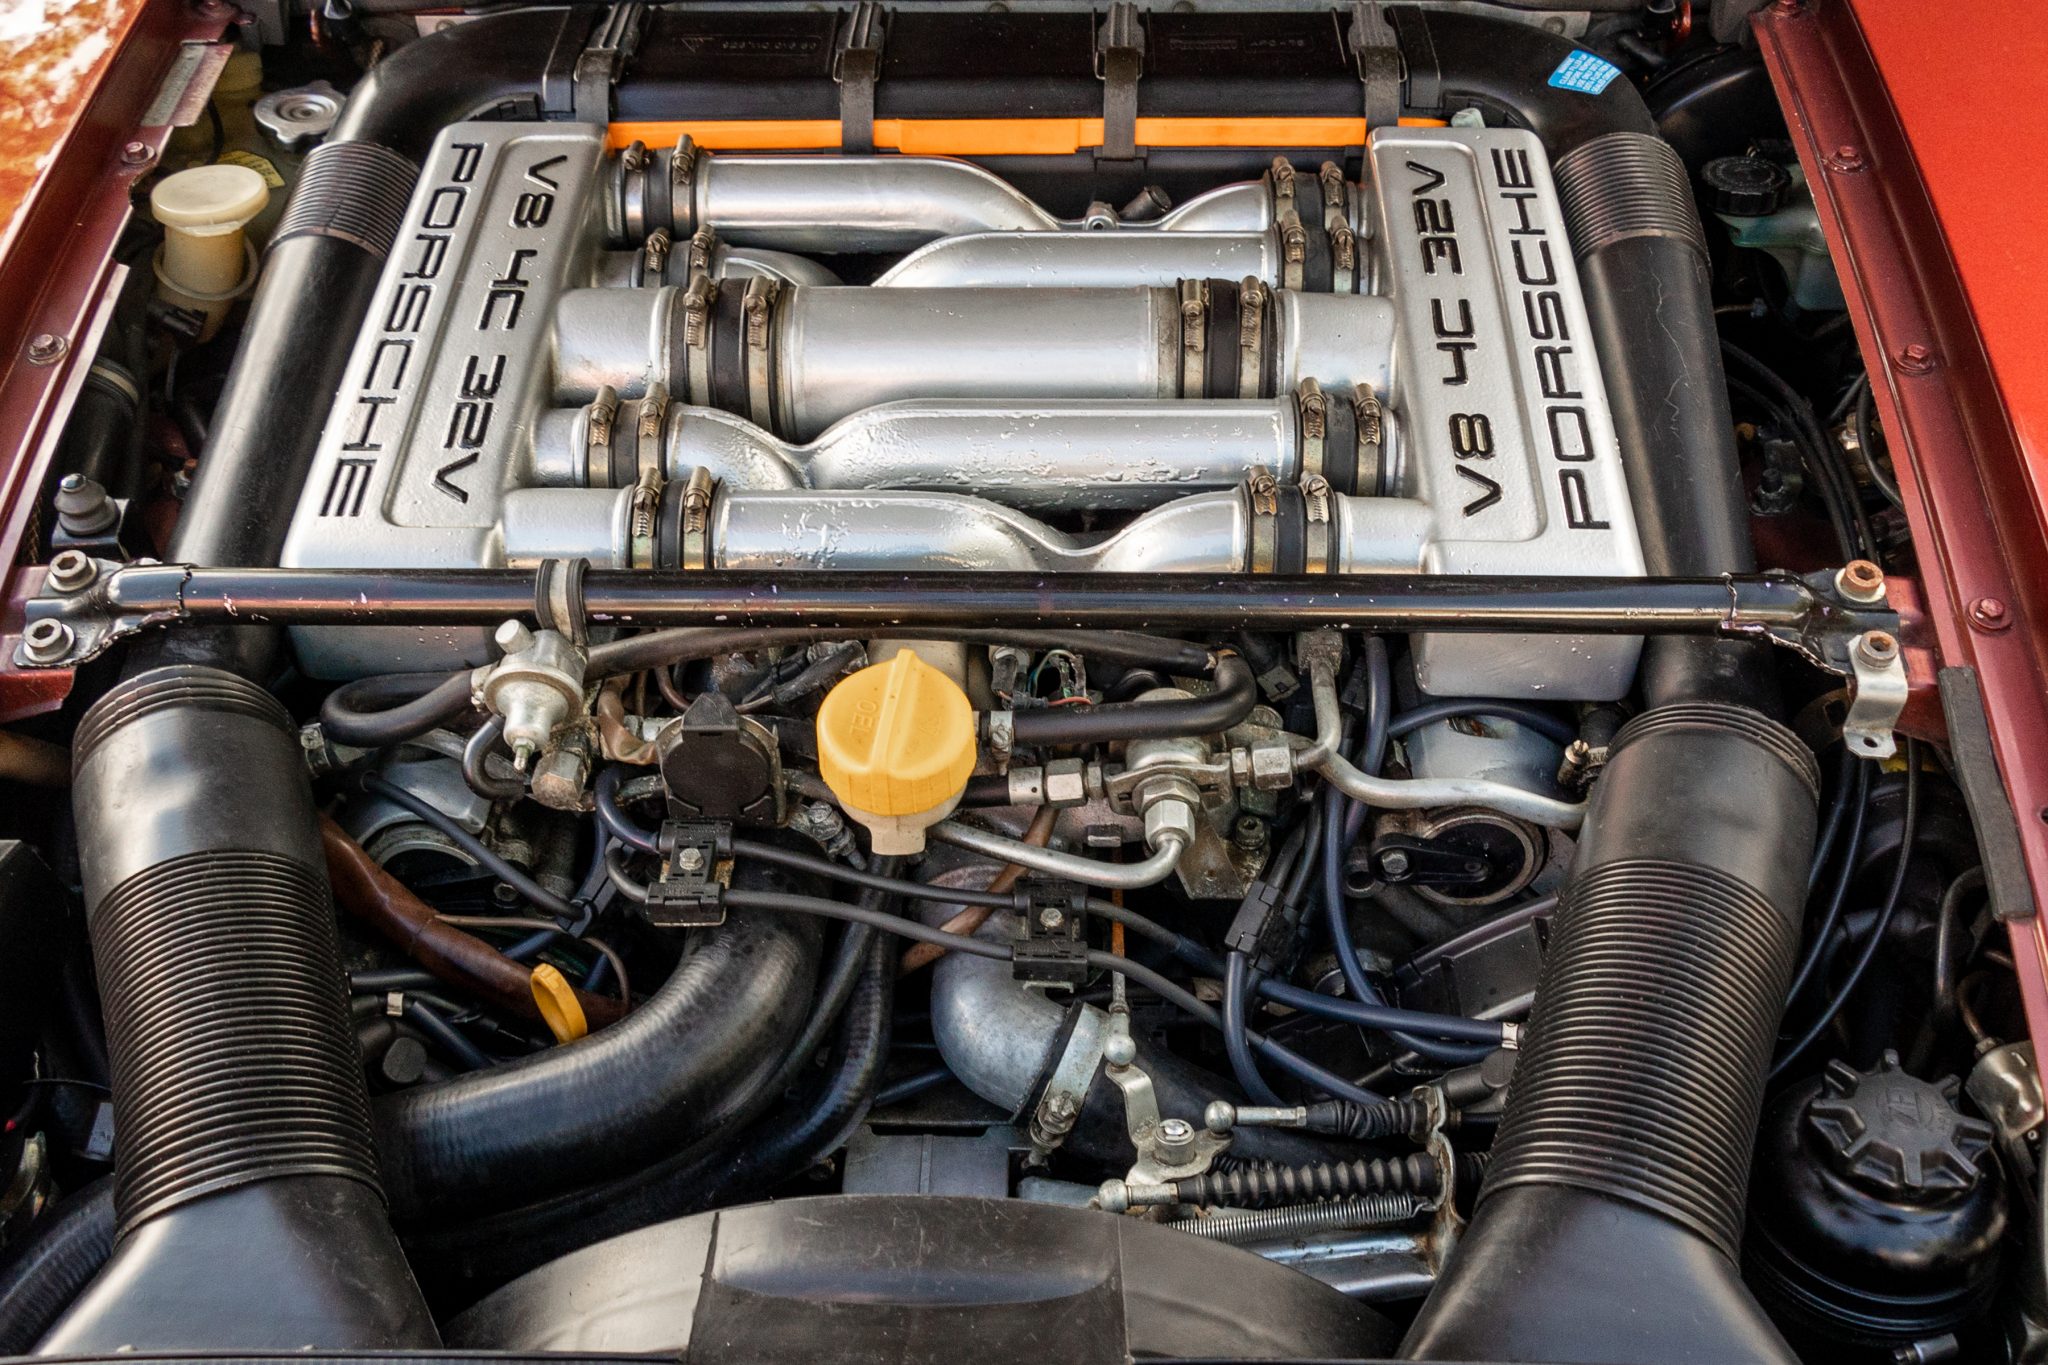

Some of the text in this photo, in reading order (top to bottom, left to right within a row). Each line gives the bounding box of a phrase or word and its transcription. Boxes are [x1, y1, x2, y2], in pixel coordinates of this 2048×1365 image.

[319, 143, 488, 517] PORSCHE
[431, 154, 567, 504] V8 4C 32V
[1406, 160, 1503, 517] V8 4C 32V
[1490, 148, 1611, 530] PORSCHE
